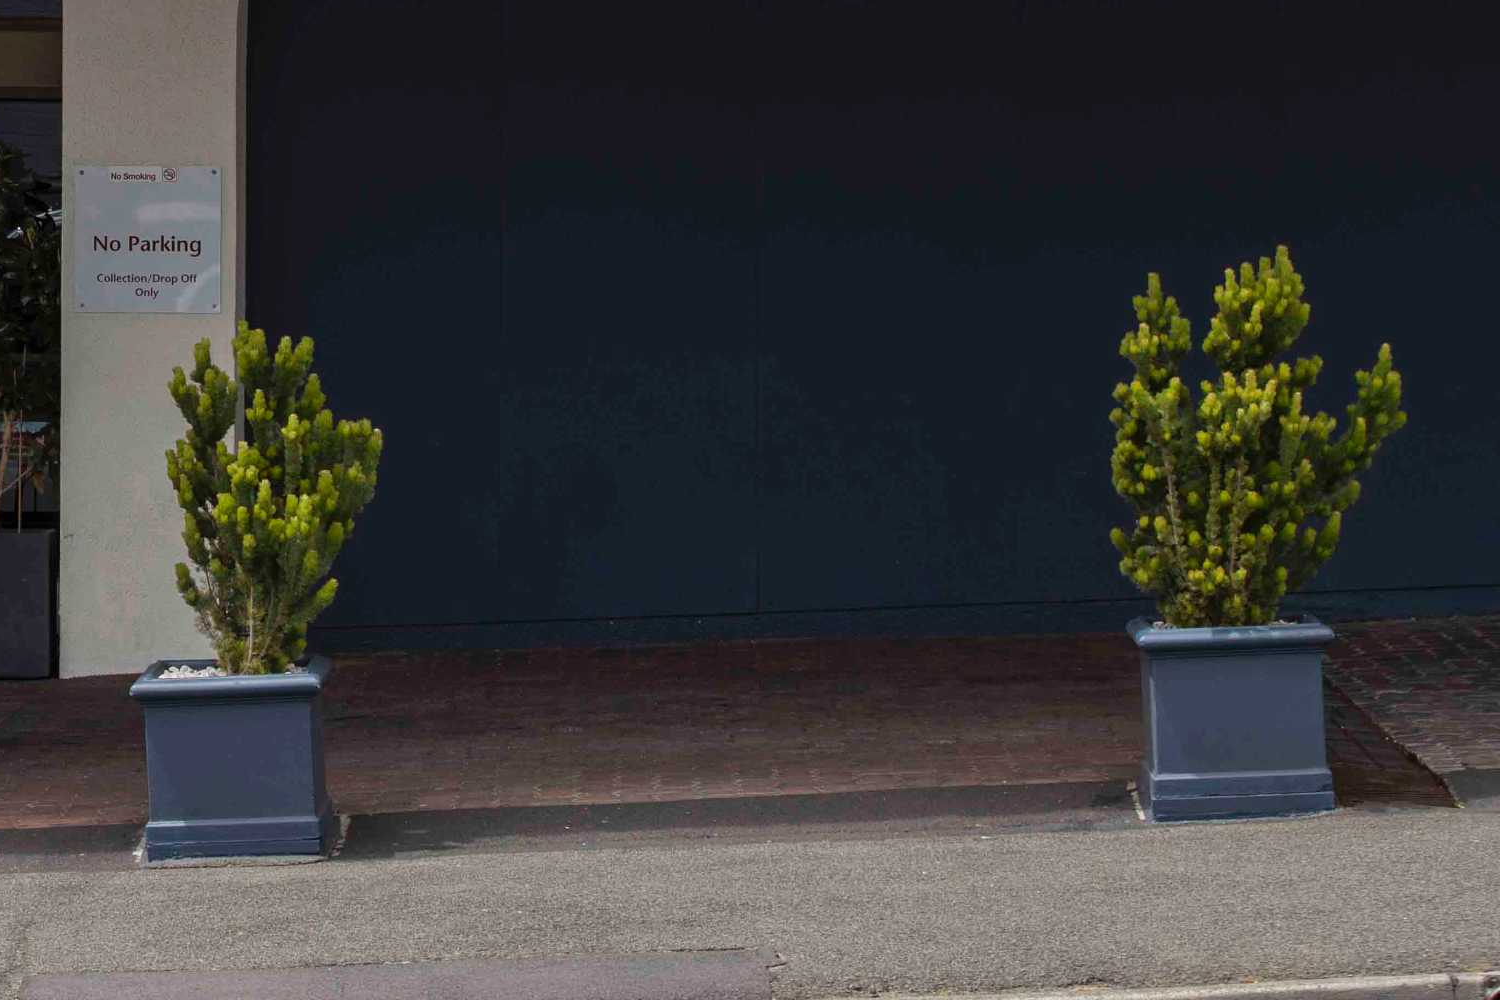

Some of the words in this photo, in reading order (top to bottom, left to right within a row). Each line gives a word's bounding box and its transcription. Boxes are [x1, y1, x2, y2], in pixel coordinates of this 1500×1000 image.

[111, 172, 121, 180] No
[123, 172, 156, 181] Smoking
[93, 236, 121, 252] No
[128, 235, 202, 257] Parking
[97, 273, 178, 285] Collection/Drop
[181, 273, 197, 283] Off
[135, 288, 159, 298] Only
